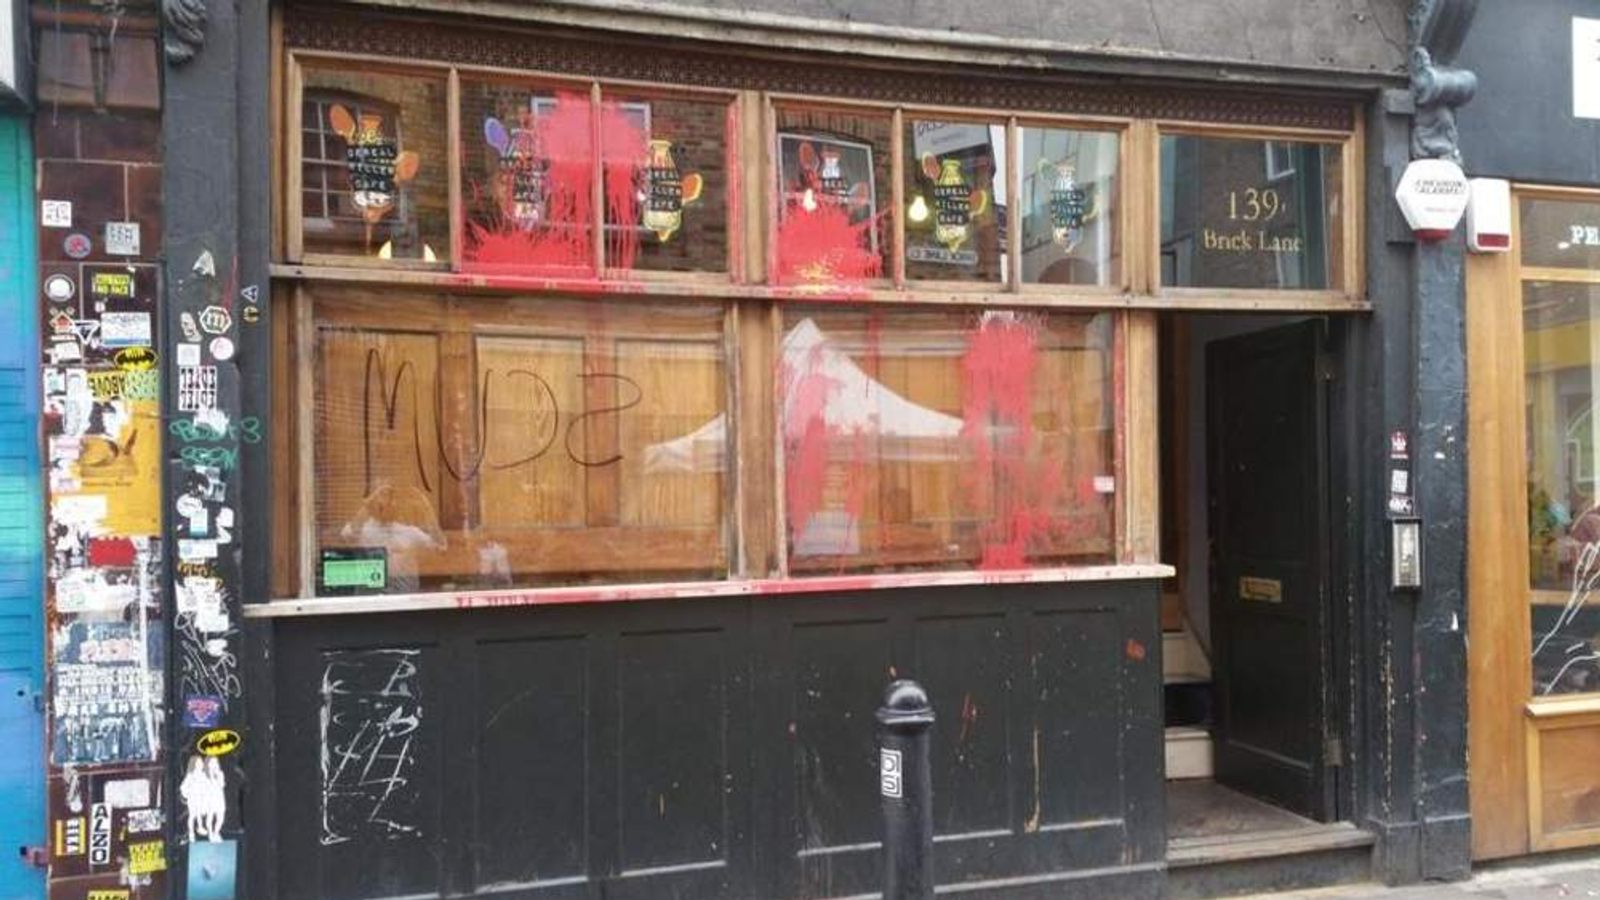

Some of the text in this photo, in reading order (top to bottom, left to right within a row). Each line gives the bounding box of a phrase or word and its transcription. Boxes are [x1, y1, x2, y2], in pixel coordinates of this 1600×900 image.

[1229, 187, 1280, 221] 139
[1203, 228, 1305, 252] Brick Lane
[1570, 225, 1600, 245] PE
